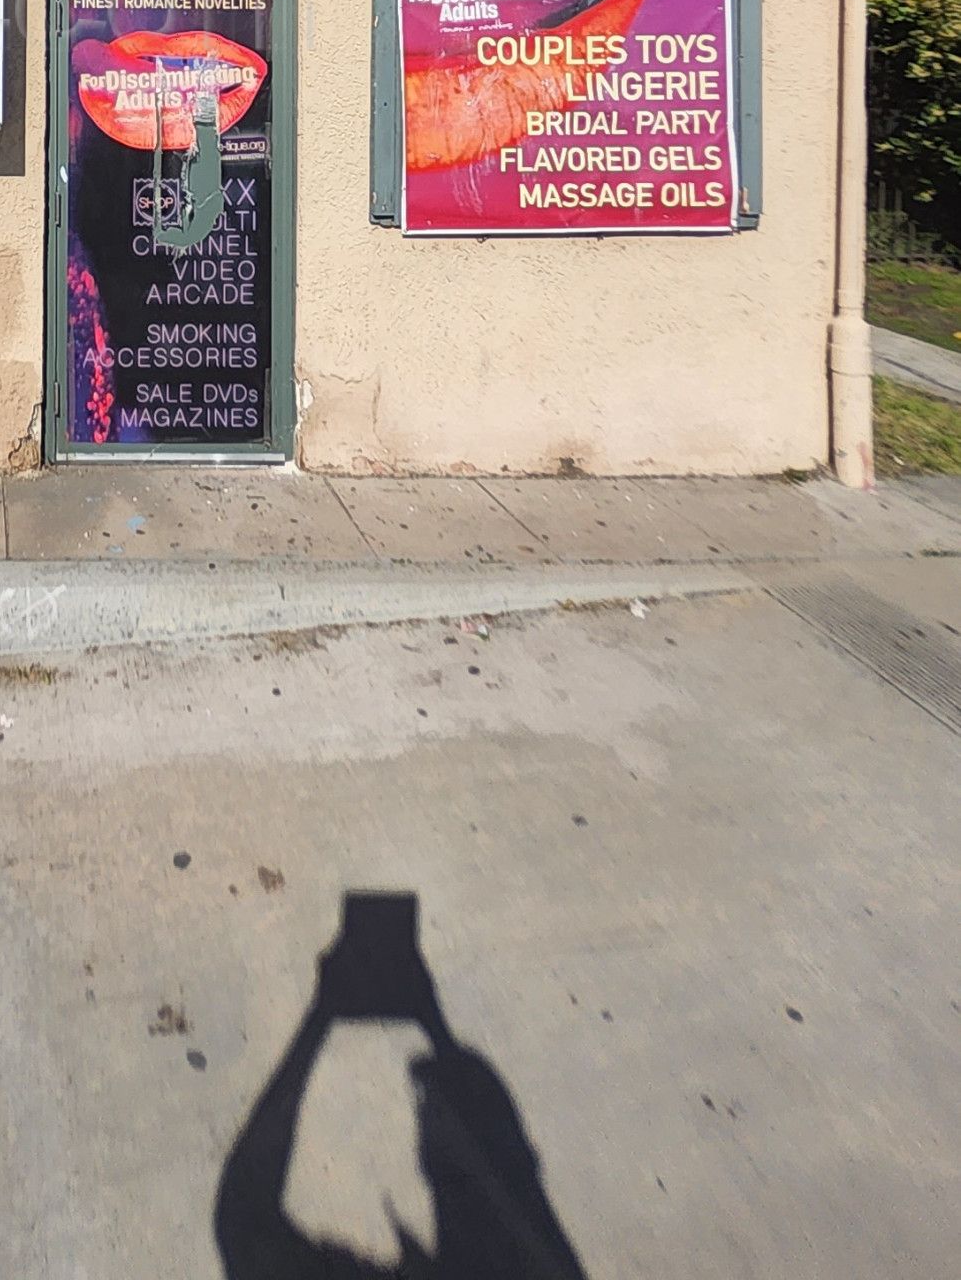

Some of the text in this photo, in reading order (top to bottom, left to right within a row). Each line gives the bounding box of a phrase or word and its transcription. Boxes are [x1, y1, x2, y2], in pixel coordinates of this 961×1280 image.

[440, 2, 499, 22] Adults
[476, 35, 717, 66] COUPLES TOYS
[566, 72, 719, 101] LINGERIE
[526, 110, 721, 136] BRIDAL PARTY
[500, 147, 722, 172] FLAVORED GELS
[519, 183, 725, 208] MASSAGE OILS
[173, 260, 256, 281] VIDEO
[146, 284, 255, 305] ARCADE
[147, 324, 256, 344] SMOKING
[83, 347, 258, 368] ACCESSORIES
[136, 384, 258, 403] SALE DVDs
[120, 408, 258, 428] MAGAZINES
